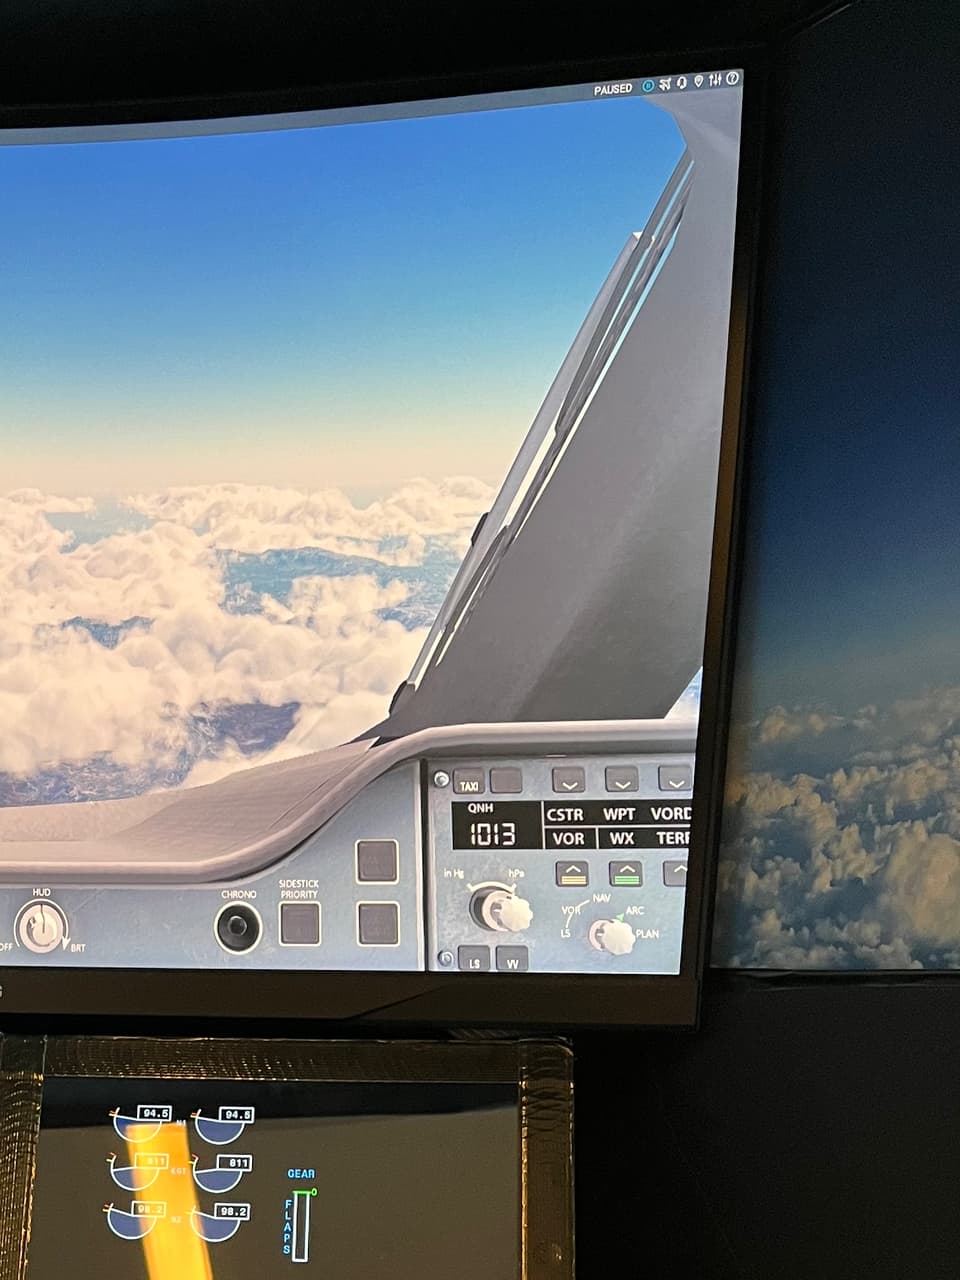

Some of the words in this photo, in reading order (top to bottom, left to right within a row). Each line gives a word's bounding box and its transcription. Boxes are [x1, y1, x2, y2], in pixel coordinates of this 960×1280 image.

[594, 83, 633, 96] PAUSED
[460, 782, 479, 792] TAXI
[468, 803, 494, 813] QNH
[547, 809, 584, 821] CSTR
[603, 808, 636, 821] WPT
[471, 823, 515, 845] 1013
[552, 833, 585, 845] VOR
[609, 832, 635, 845] WX
[508, 869, 525, 878] hPa
[278, 879, 319, 889] SIDESTICK
[32, 888, 51, 897] HUD
[221, 890, 257, 899] CHRONO
[280, 890, 318, 899] PRIORITY
[592, 894, 611, 903] NAV
[561, 906, 581, 915] VOR
[626, 906, 644, 915] ARC
[560, 929, 571, 938] LS
[636, 930, 659, 939] PLAN
[70, 944, 86, 953] BRT
[469, 959, 480, 969] LS
[144, 1109, 168, 1119] 94.5
[226, 1111, 251, 1120] 94.5
[230, 1158, 248, 1167] 811
[288, 1168, 315, 1178] GEAR
[221, 1207, 247, 1217] 98.2
[283, 1200, 292, 1254] FLAPS
